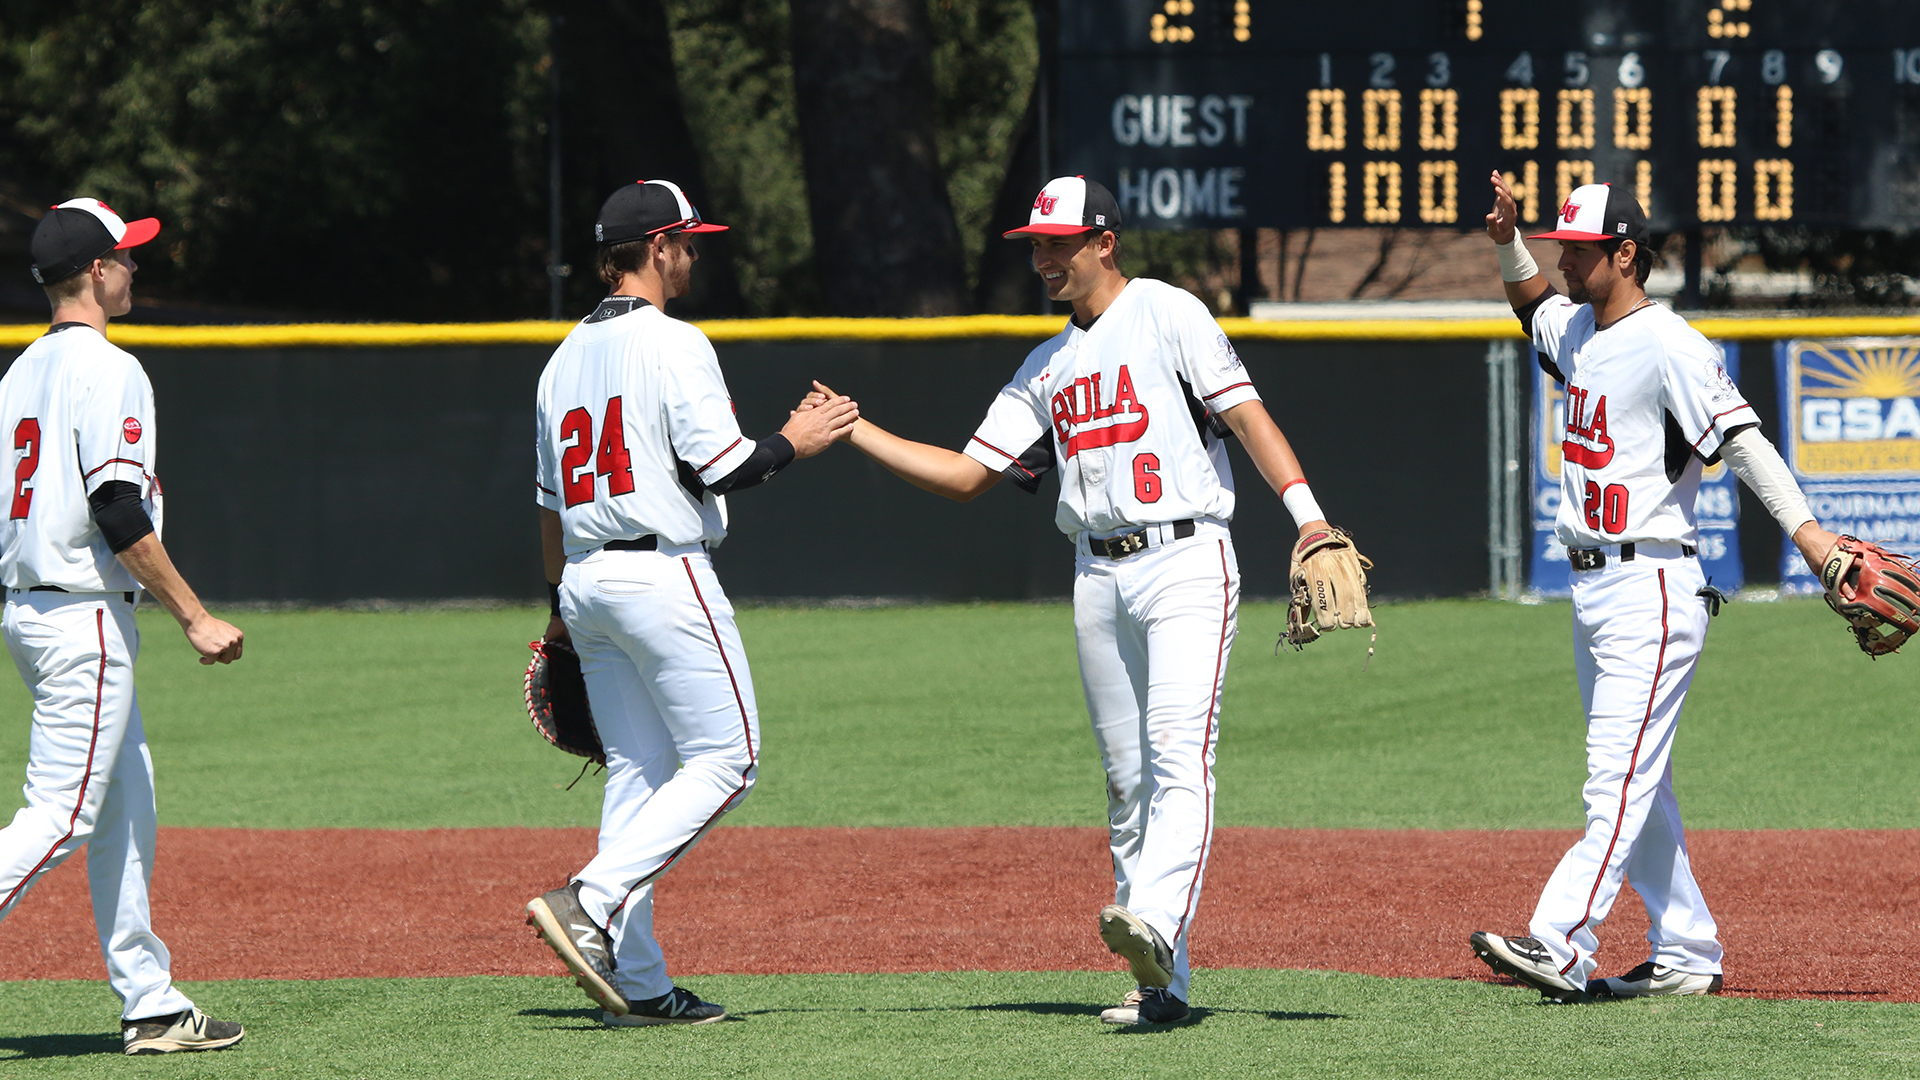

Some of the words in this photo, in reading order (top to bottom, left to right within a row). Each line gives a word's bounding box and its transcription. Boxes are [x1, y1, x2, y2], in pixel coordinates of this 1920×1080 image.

[1319, 53, 1331, 87] 1
[1370, 52, 1395, 87] 2
[1427, 52, 1451, 87] 3
[1506, 51, 1534, 86] 4
[1565, 51, 1590, 87] 5
[1618, 52, 1645, 88] 6
[1705, 50, 1731, 84] 7
[1762, 49, 1786, 85] 8
[1815, 49, 1843, 84] 9
[1112, 95, 1252, 147] GUEST
[1308, 88, 1346, 151] 0
[1363, 88, 1402, 151] 0
[1419, 88, 1458, 151] 0
[1501, 87, 1540, 150] 0
[1556, 88, 1596, 150] 0
[1613, 87, 1652, 150] 0
[1697, 85, 1737, 148] 0
[1776, 84, 1793, 148] 1
[1118, 167, 1246, 219] HOME
[1329, 161, 1346, 223] 1
[1363, 161, 1402, 223] 0
[1419, 160, 1458, 223] 0
[1697, 158, 1737, 222] 0
[1754, 158, 1794, 221] 0
[9, 417, 41, 520] 2
[560, 395, 636, 509] 24
[1132, 452, 1162, 504] 6
[1584, 479, 1629, 535] 20
[1316, 580, 1328, 611] A2000
